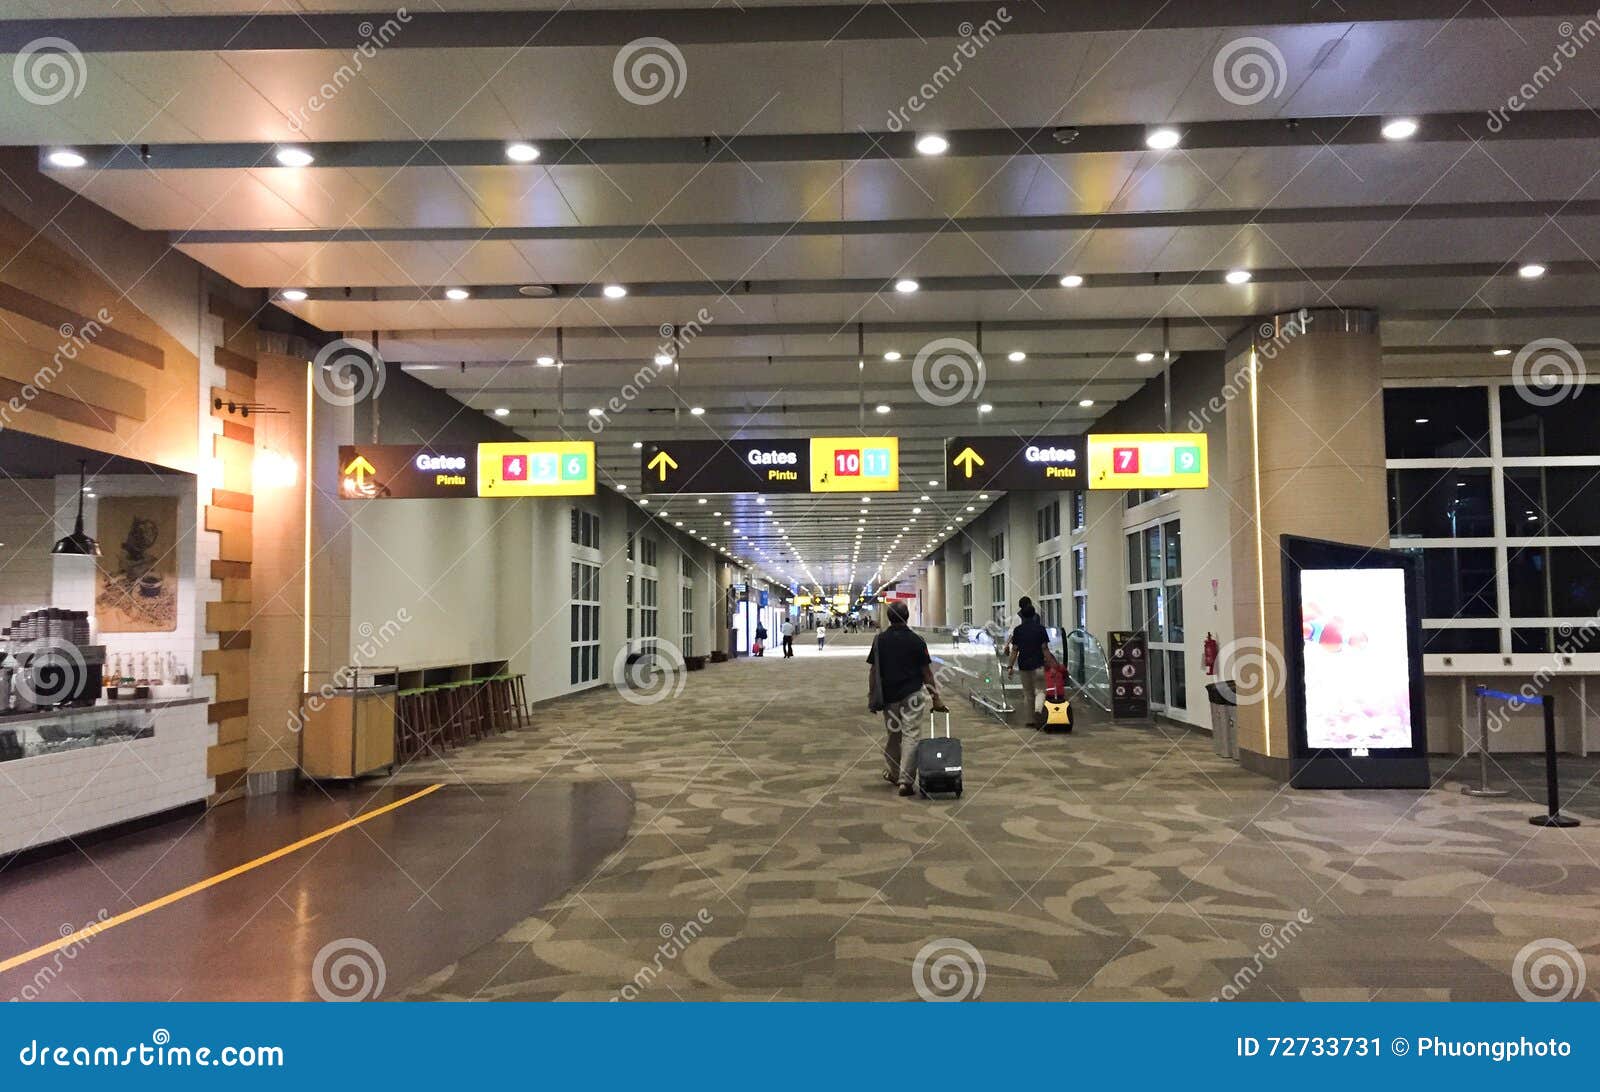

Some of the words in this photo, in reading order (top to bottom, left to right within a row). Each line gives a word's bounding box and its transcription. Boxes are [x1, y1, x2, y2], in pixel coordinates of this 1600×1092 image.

[415, 454, 466, 470] Gates
[748, 449, 798, 465] Gates
[1025, 446, 1076, 462] Gates
[1119, 451, 1133, 469] 7
[1180, 453, 1194, 468] 9
[508, 458, 522, 476] 4
[567, 458, 581, 475] 6
[836, 454, 859, 472] 10
[867, 454, 888, 471] 11
[436, 474, 466, 486] Pintu
[768, 469, 798, 481] Pintu
[1046, 466, 1076, 478] Pintu
